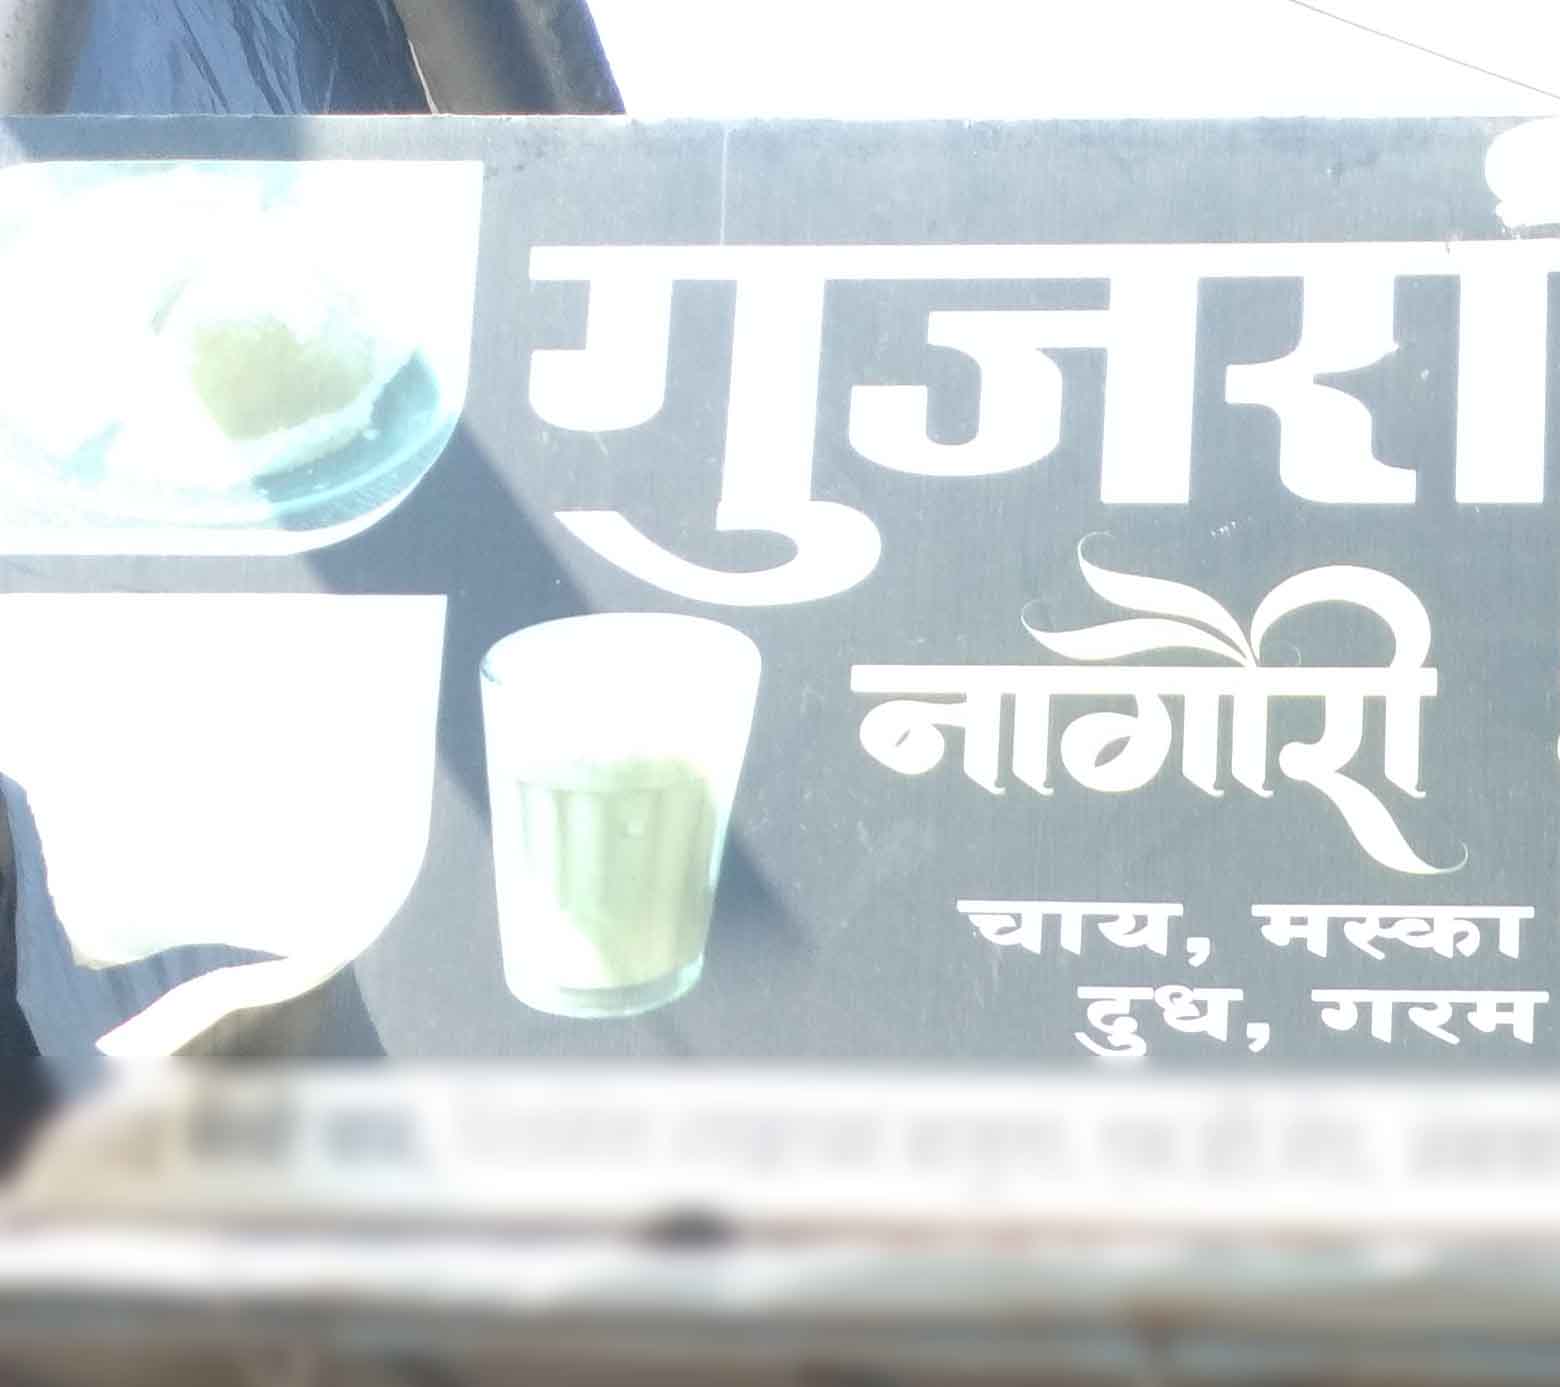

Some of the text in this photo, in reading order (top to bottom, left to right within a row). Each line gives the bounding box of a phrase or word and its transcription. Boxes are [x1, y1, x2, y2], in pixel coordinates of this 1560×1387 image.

[850, 531, 1469, 876] नागौरी
[956, 899, 1211, 968] चाय,
[1251, 904, 1536, 961] मस्का
[1074, 983, 1271, 1058] दुध,
[1310, 989, 1550, 1046] गरम
